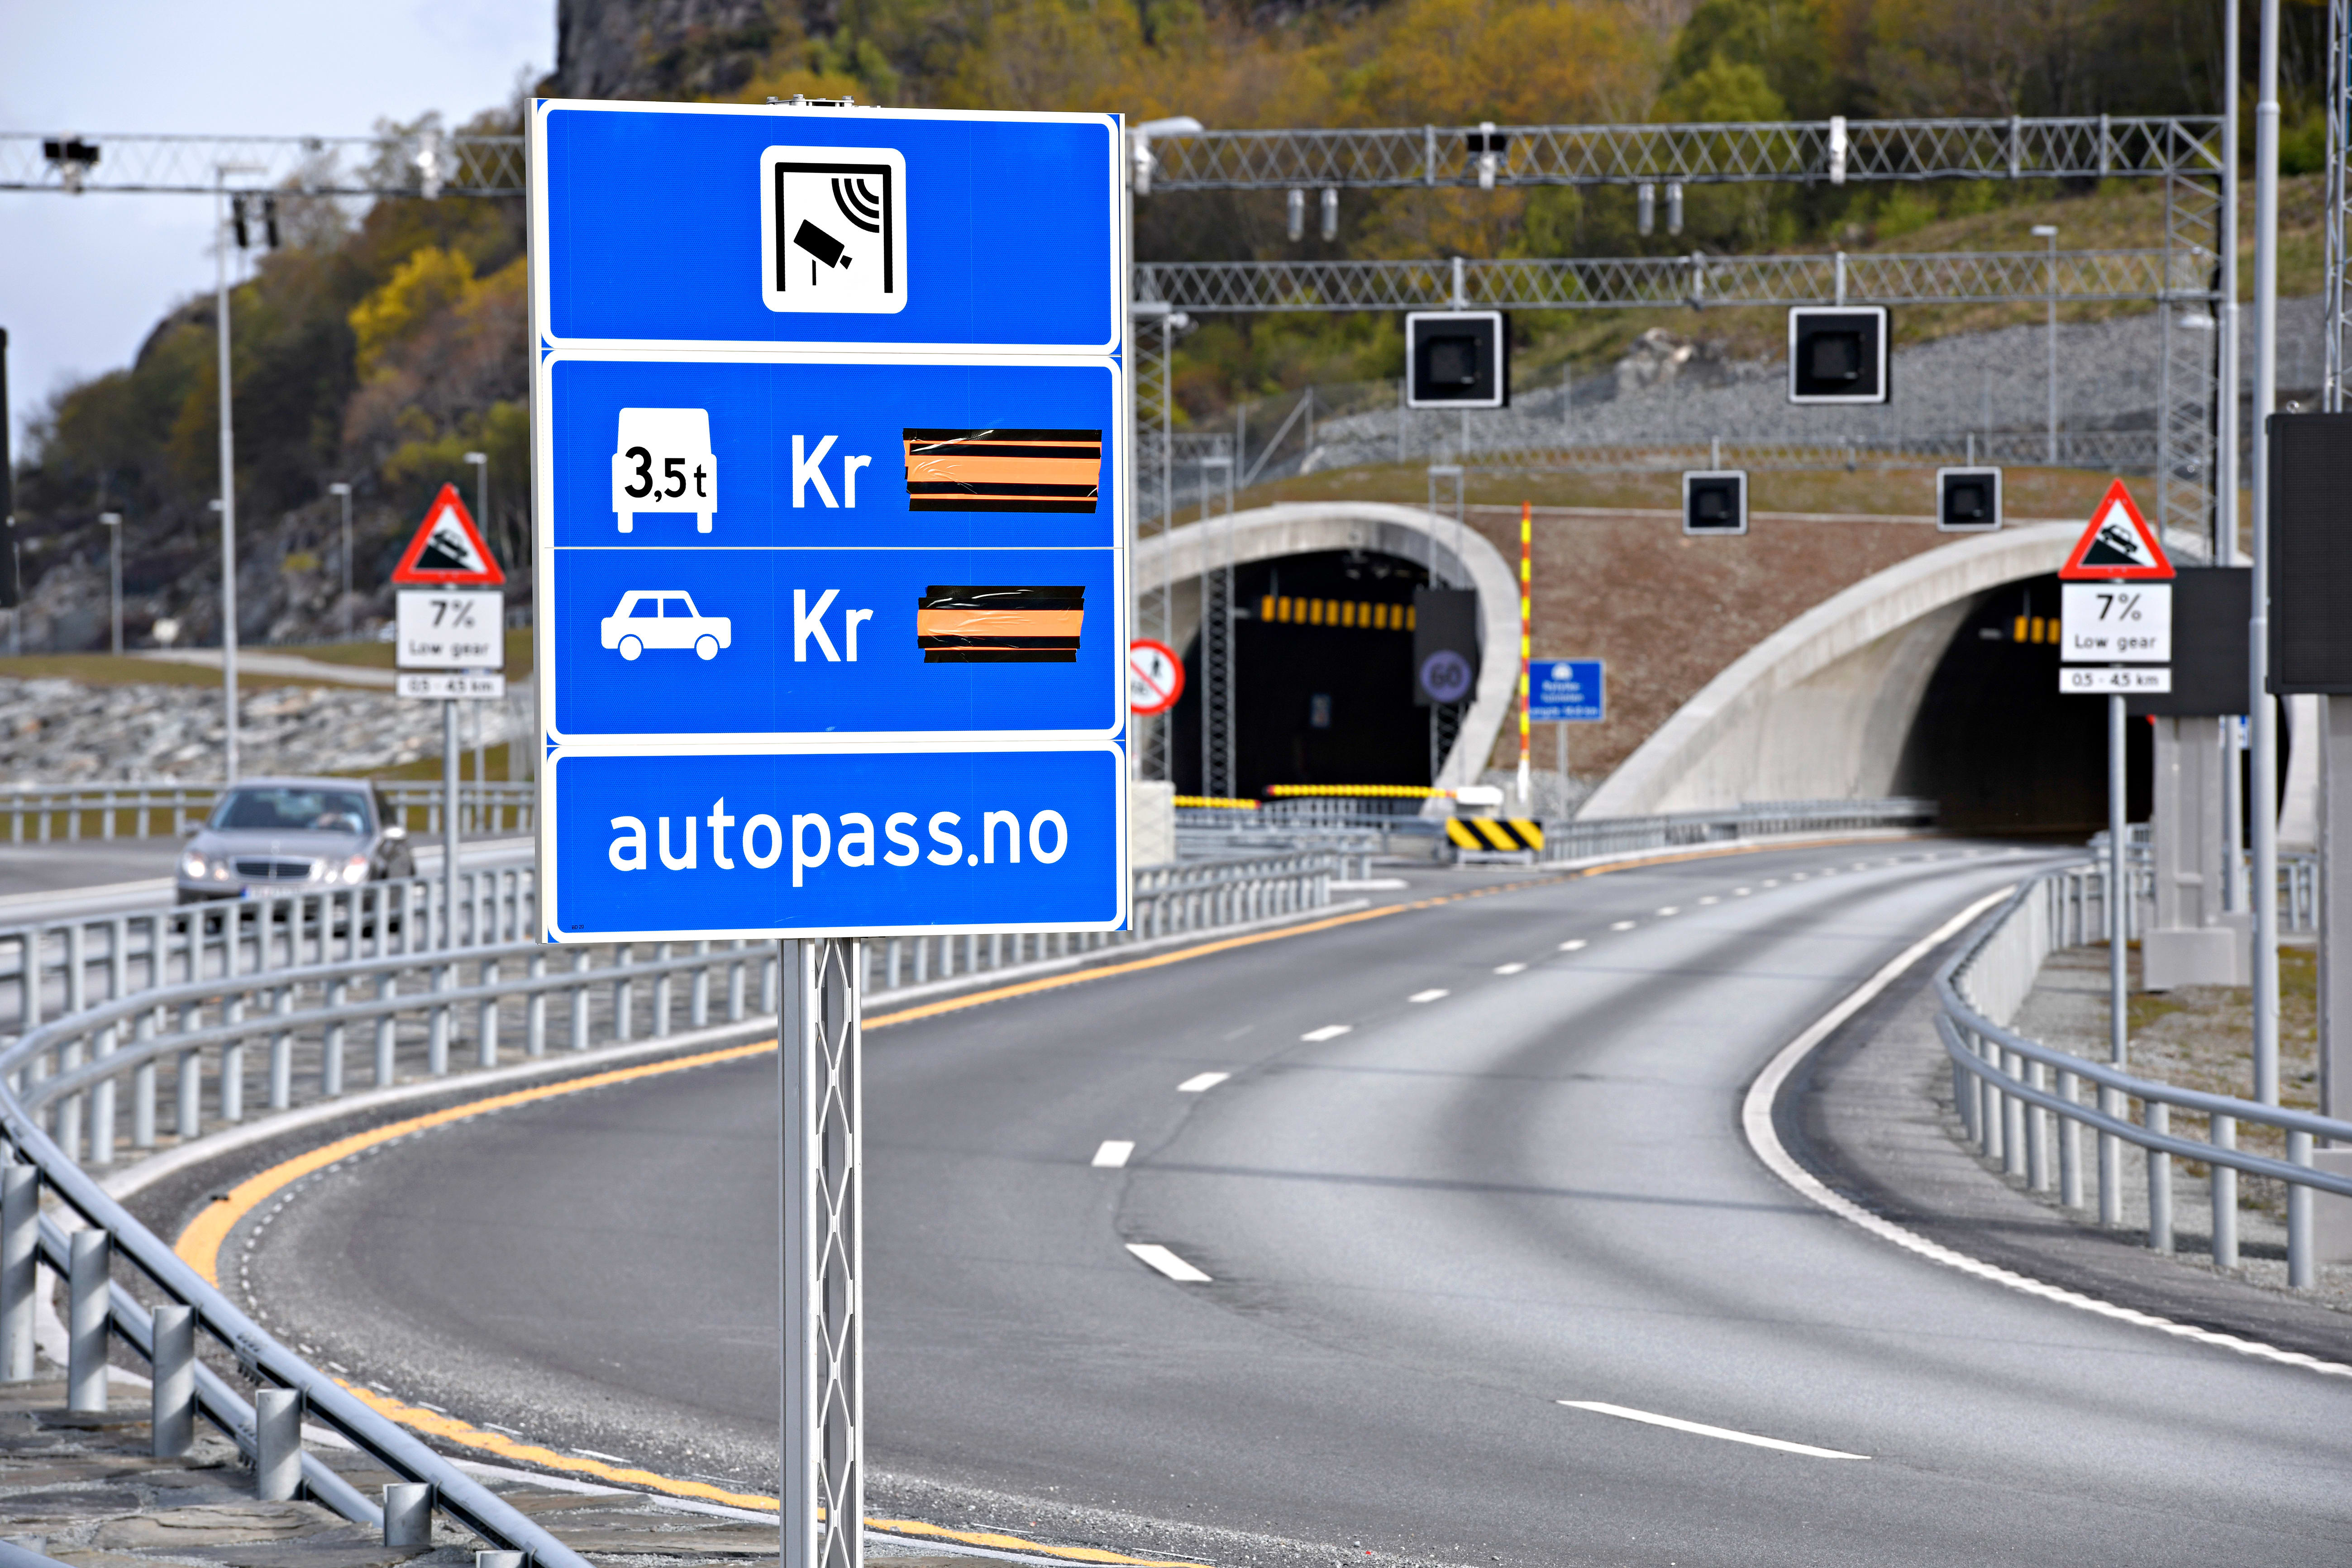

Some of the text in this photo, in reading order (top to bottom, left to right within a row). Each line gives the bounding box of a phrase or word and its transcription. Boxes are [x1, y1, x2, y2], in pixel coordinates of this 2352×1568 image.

[624, 446, 707, 502] 3,5 t
[792, 435, 872, 508] Kr
[430, 600, 474, 627] 7%
[2096, 593, 2142, 621] 7%
[793, 589, 874, 662] Kr
[409, 640, 488, 658] Low gear
[2074, 634, 2156, 653] Low gear
[2136, 673, 2159, 687] km
[609, 796, 1068, 887] autopass.no
